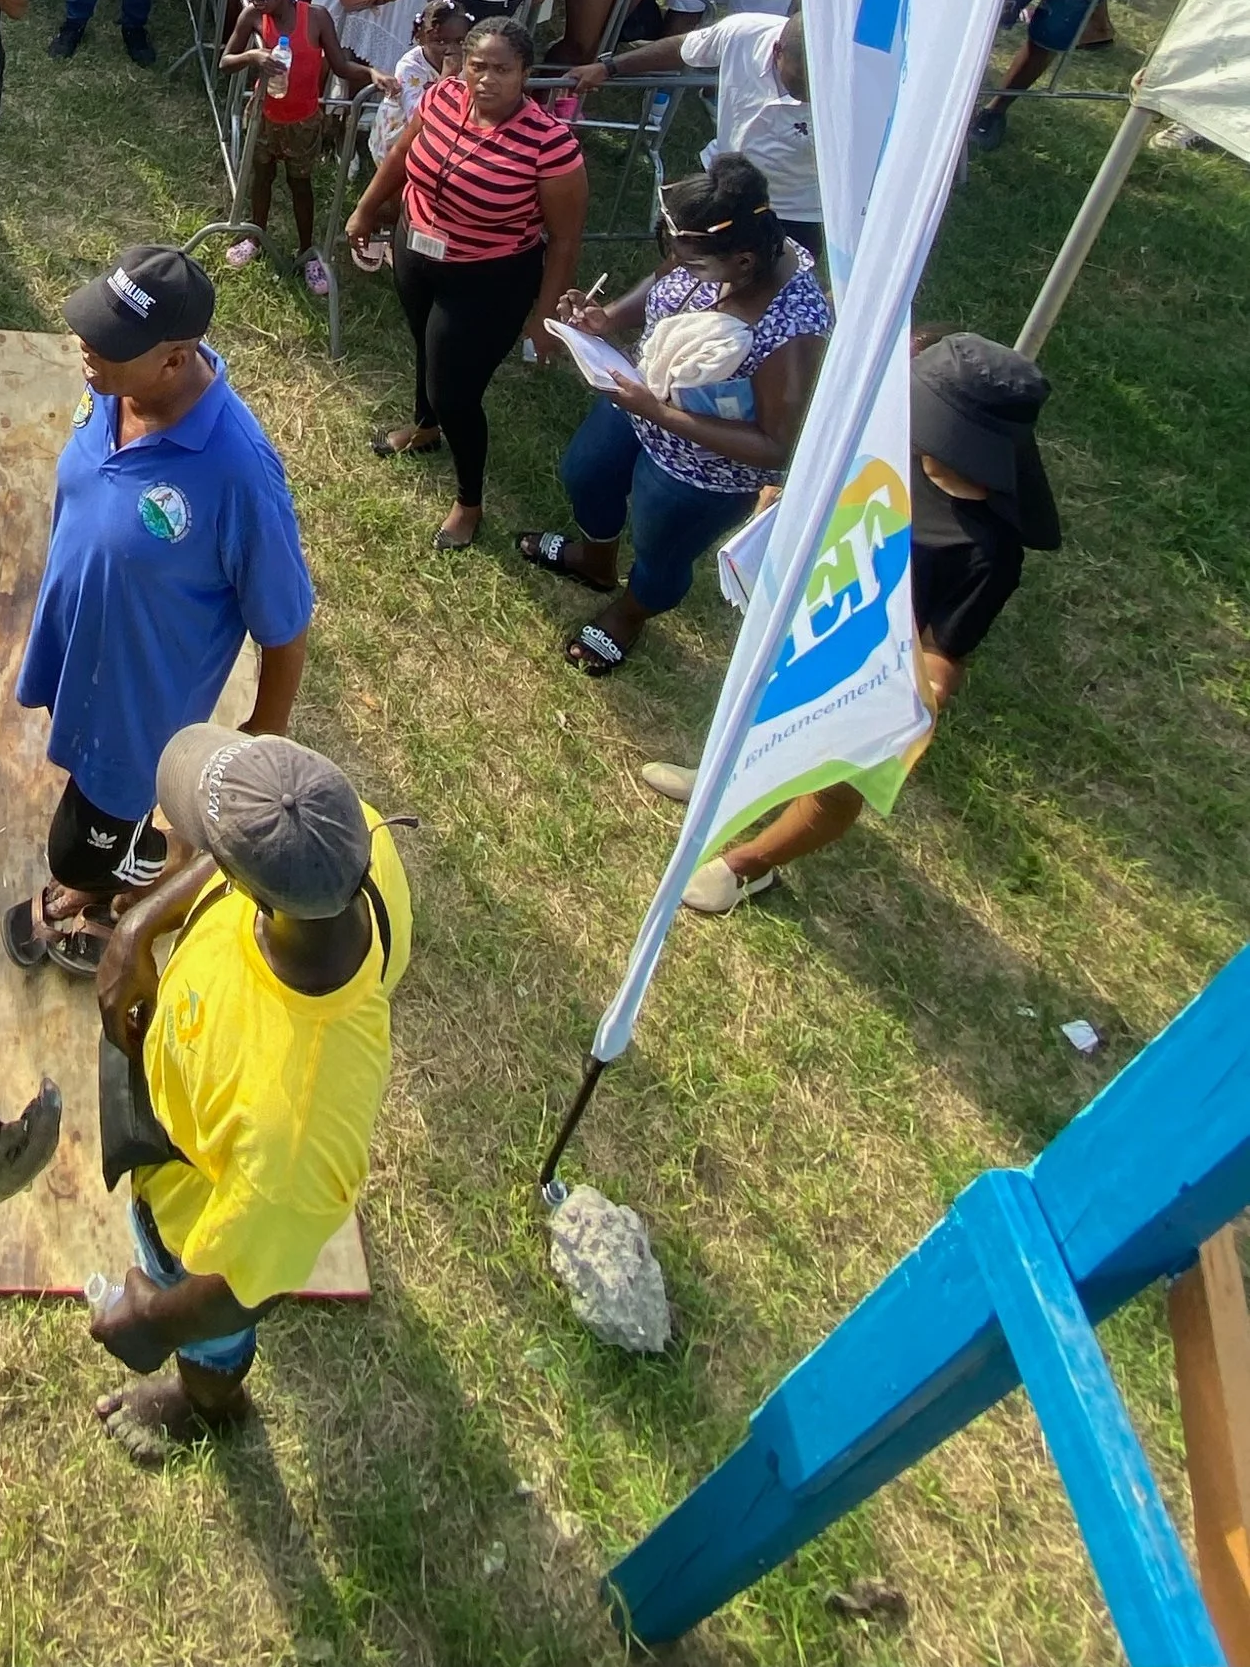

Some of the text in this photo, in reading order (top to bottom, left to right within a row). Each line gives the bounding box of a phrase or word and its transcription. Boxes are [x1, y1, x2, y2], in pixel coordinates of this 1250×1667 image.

[768, 484, 892, 683] EF
[582, 625, 623, 661] adidas
[742, 662, 889, 772] Enhancement
